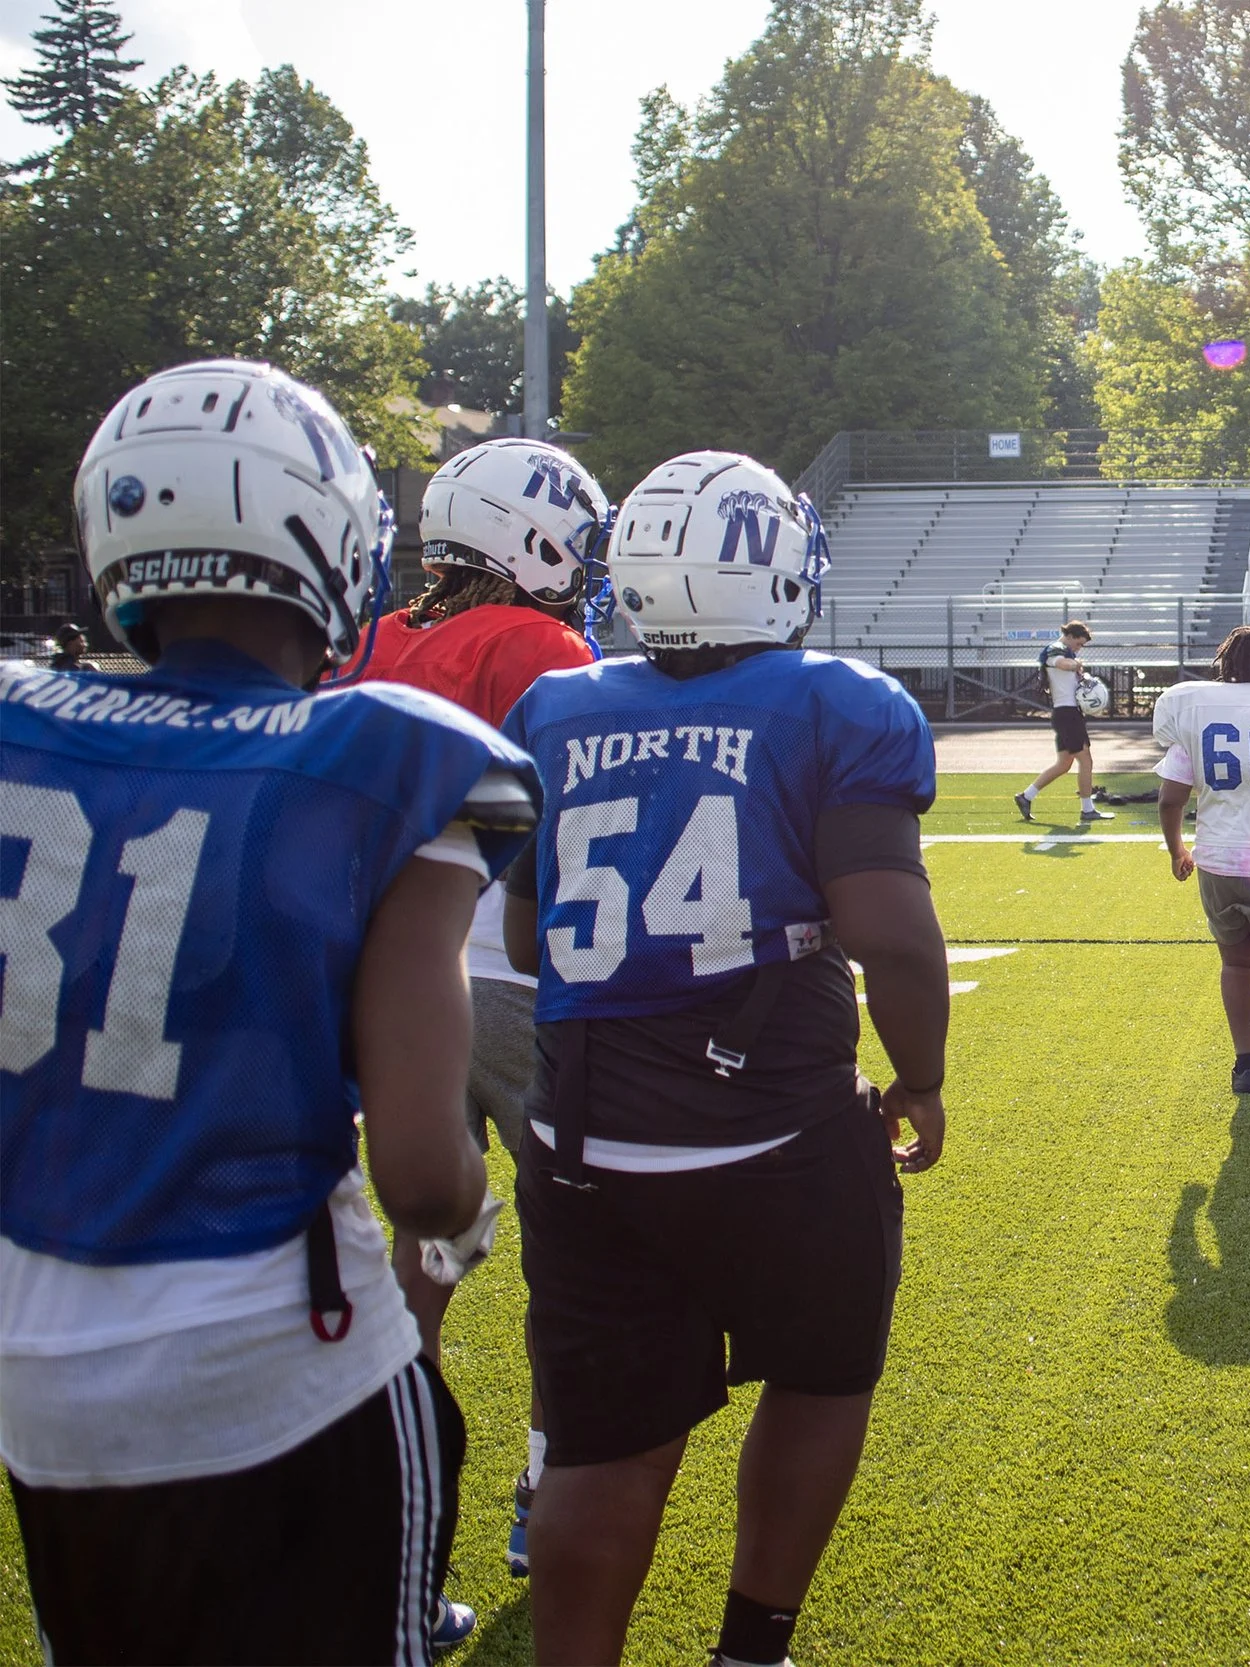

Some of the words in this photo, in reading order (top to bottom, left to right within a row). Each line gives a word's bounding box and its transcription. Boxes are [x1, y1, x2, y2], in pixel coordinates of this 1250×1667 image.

[992, 439, 1017, 450] HOME
[718, 500, 781, 567] N
[129, 551, 230, 583] schutt
[643, 630, 697, 645] schutt
[563, 726, 753, 794] NORTH
[547, 795, 755, 983] 54
